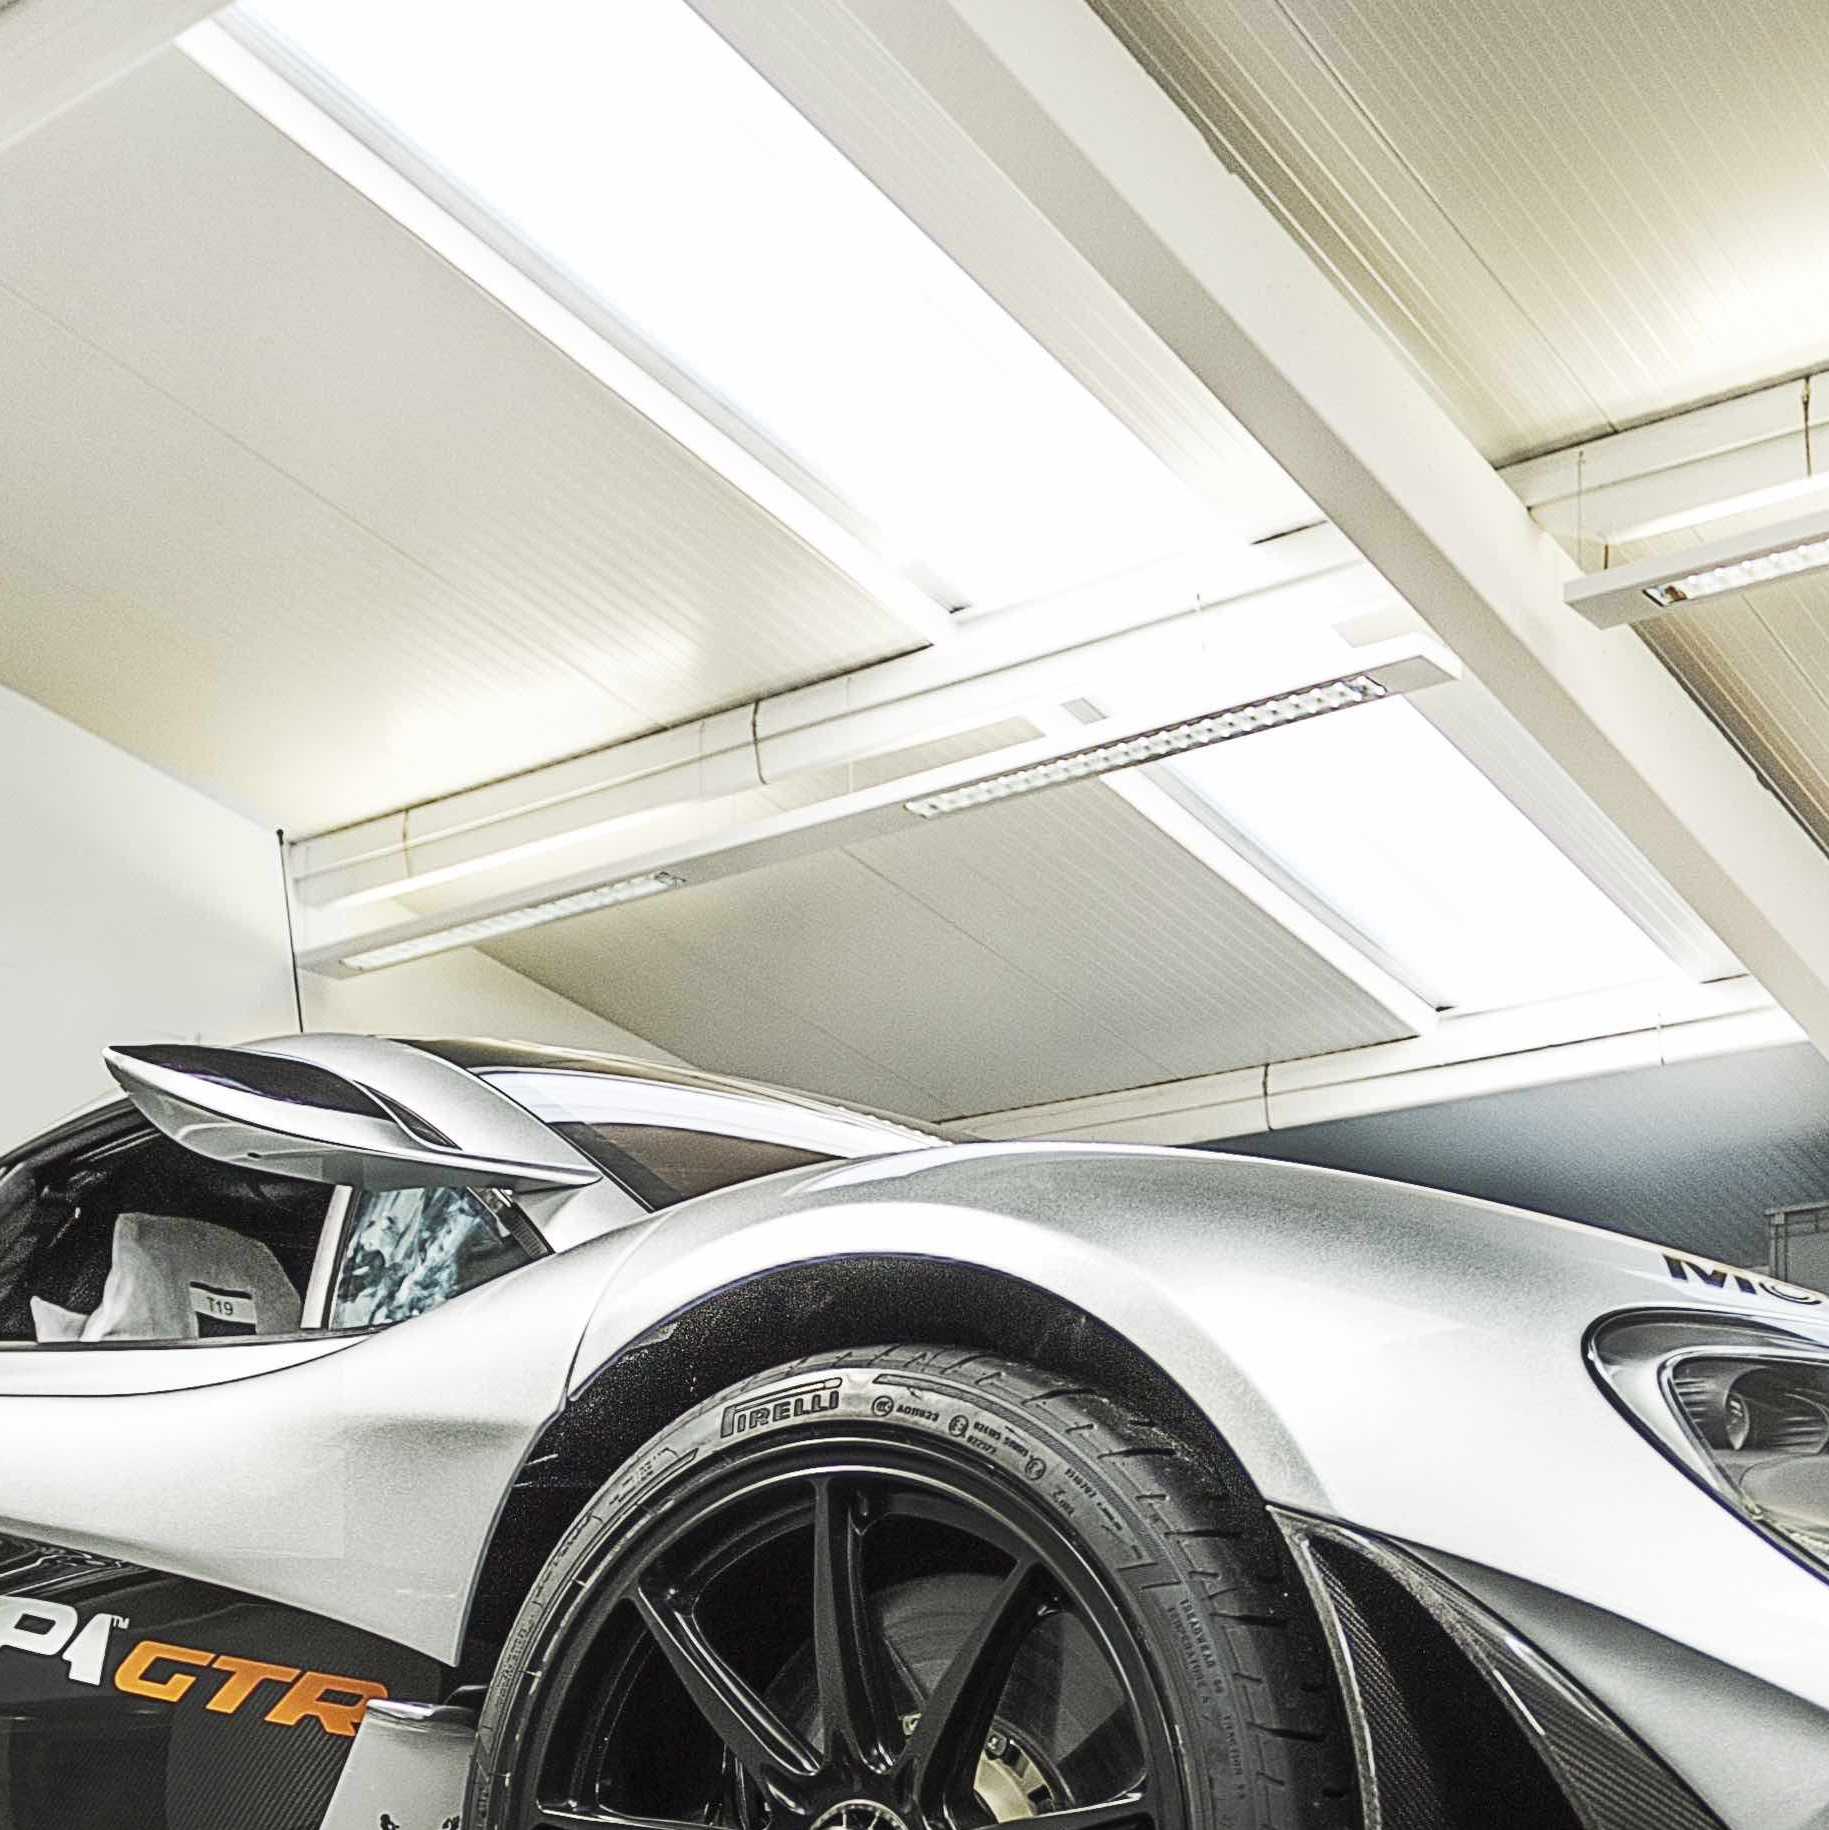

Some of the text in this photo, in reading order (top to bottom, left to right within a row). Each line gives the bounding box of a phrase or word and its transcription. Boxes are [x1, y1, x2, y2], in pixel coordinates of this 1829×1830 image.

[206, 1296, 234, 1316] T19
[721, 1376, 843, 1438] PIRELLI
[114, 1640, 389, 1737] GTR
